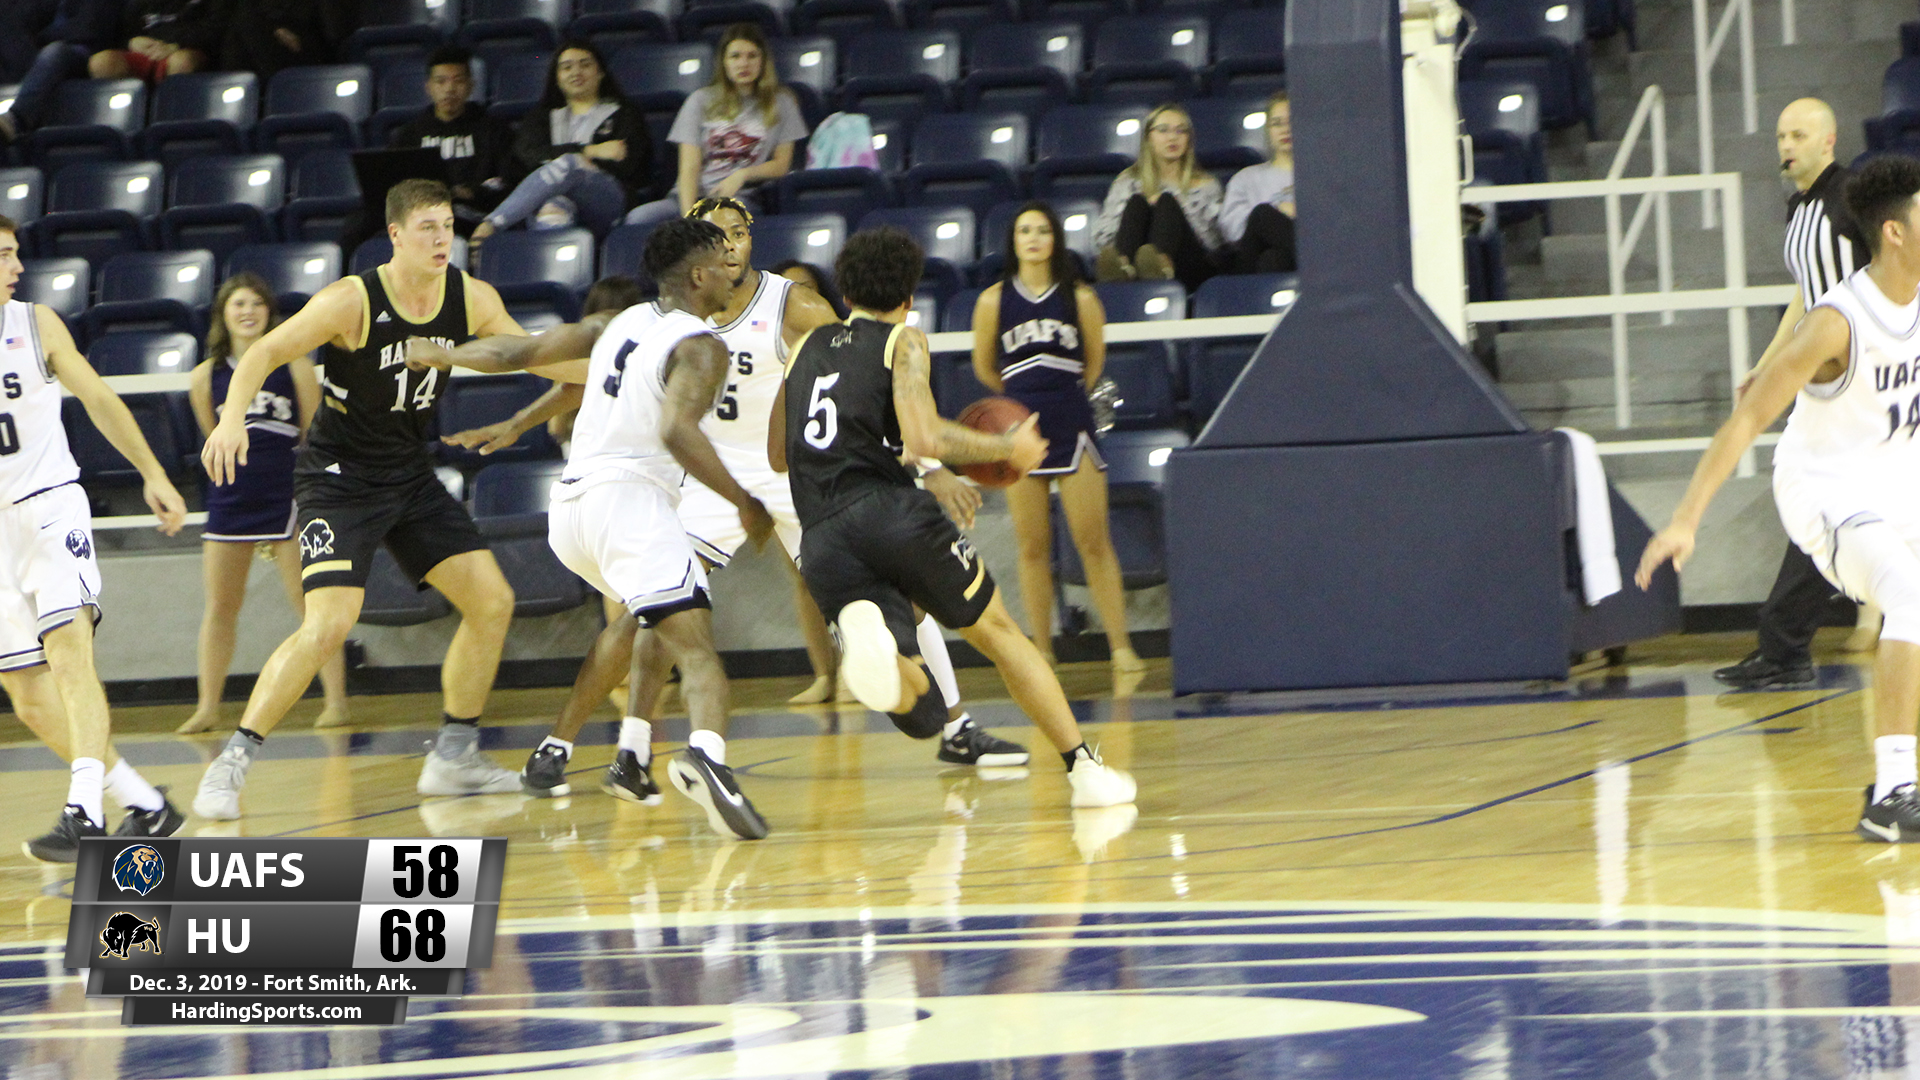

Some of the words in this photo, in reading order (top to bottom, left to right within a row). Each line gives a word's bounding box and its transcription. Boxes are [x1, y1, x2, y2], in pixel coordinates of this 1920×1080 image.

[1001, 318, 1079, 353] UAFS
[390, 367, 438, 412] 14
[804, 372, 840, 450] 5
